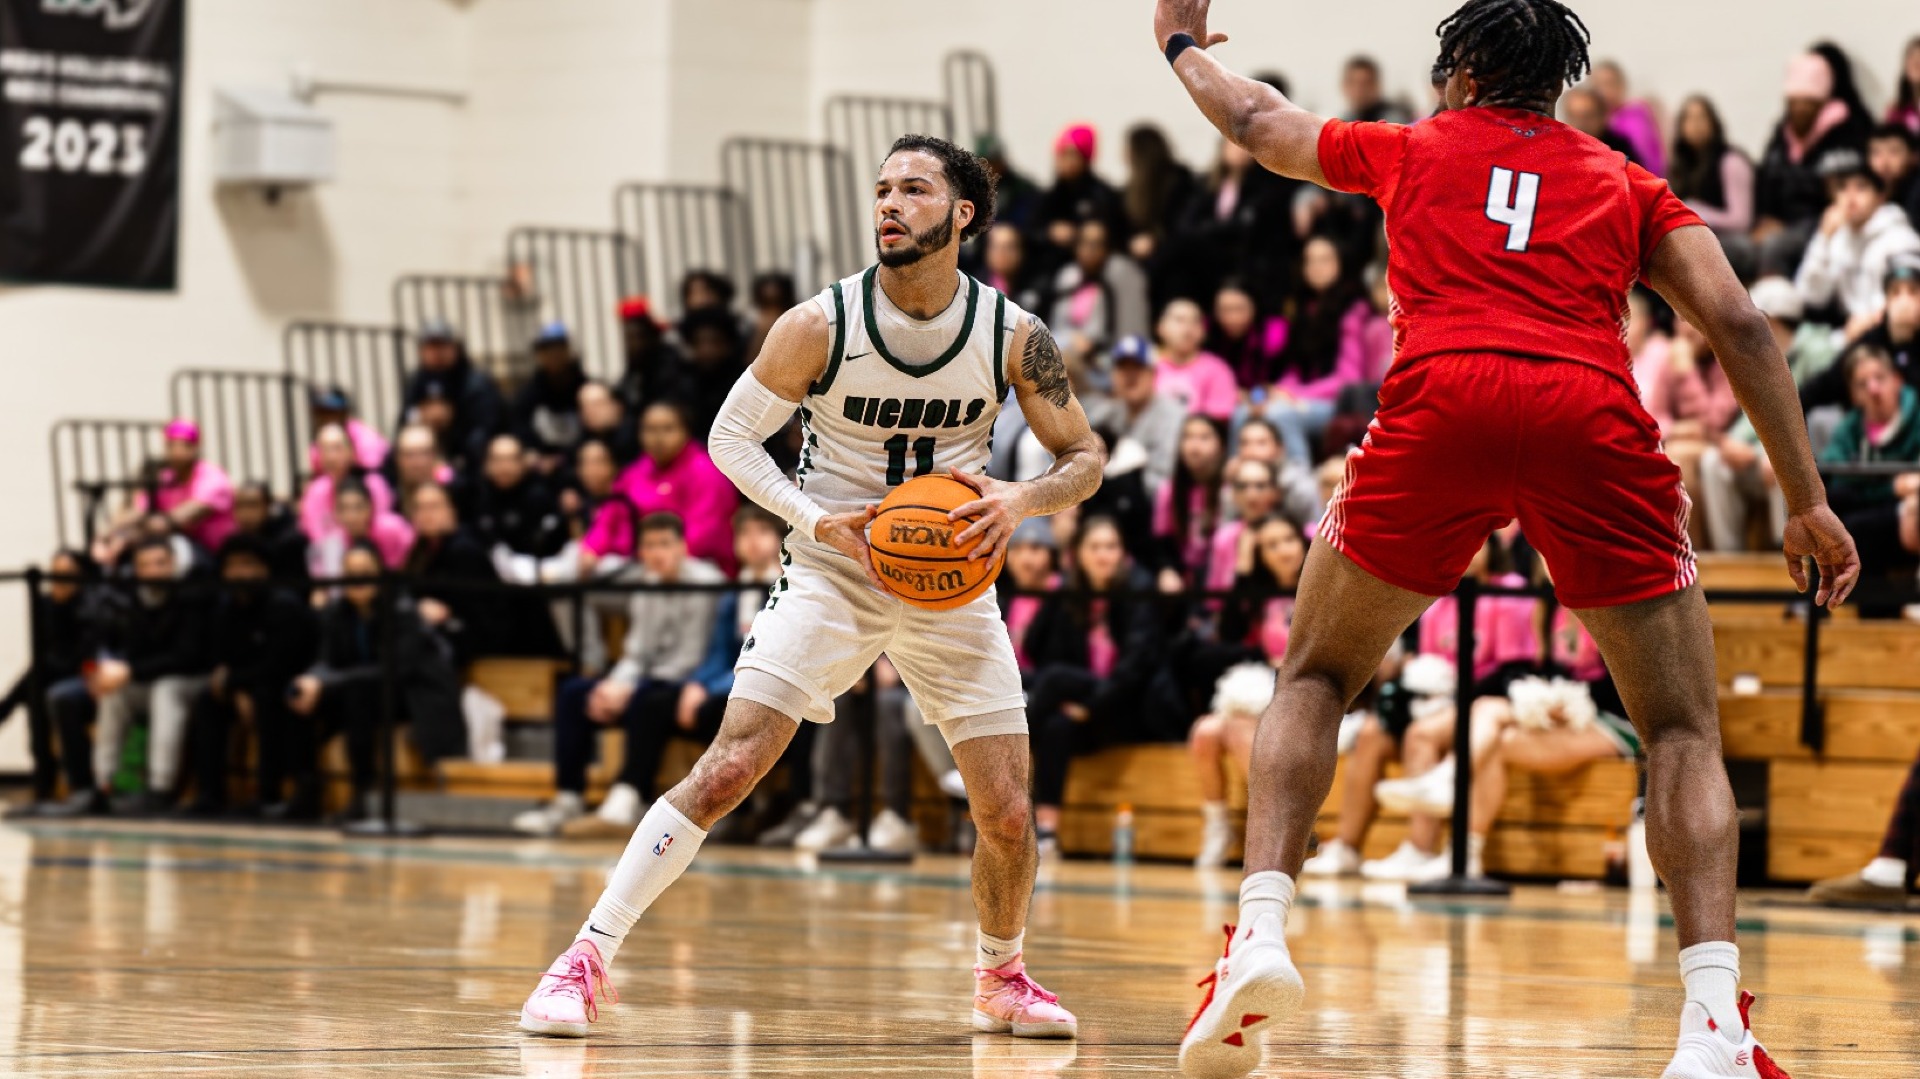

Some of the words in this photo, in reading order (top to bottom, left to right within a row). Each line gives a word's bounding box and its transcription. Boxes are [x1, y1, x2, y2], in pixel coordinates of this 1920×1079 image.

[1484, 165, 1542, 253] 4
[842, 395, 987, 429] NICHOLS
[883, 433, 936, 487] 11
[890, 523, 954, 548] NCAA
[877, 558, 966, 592] Wilson
